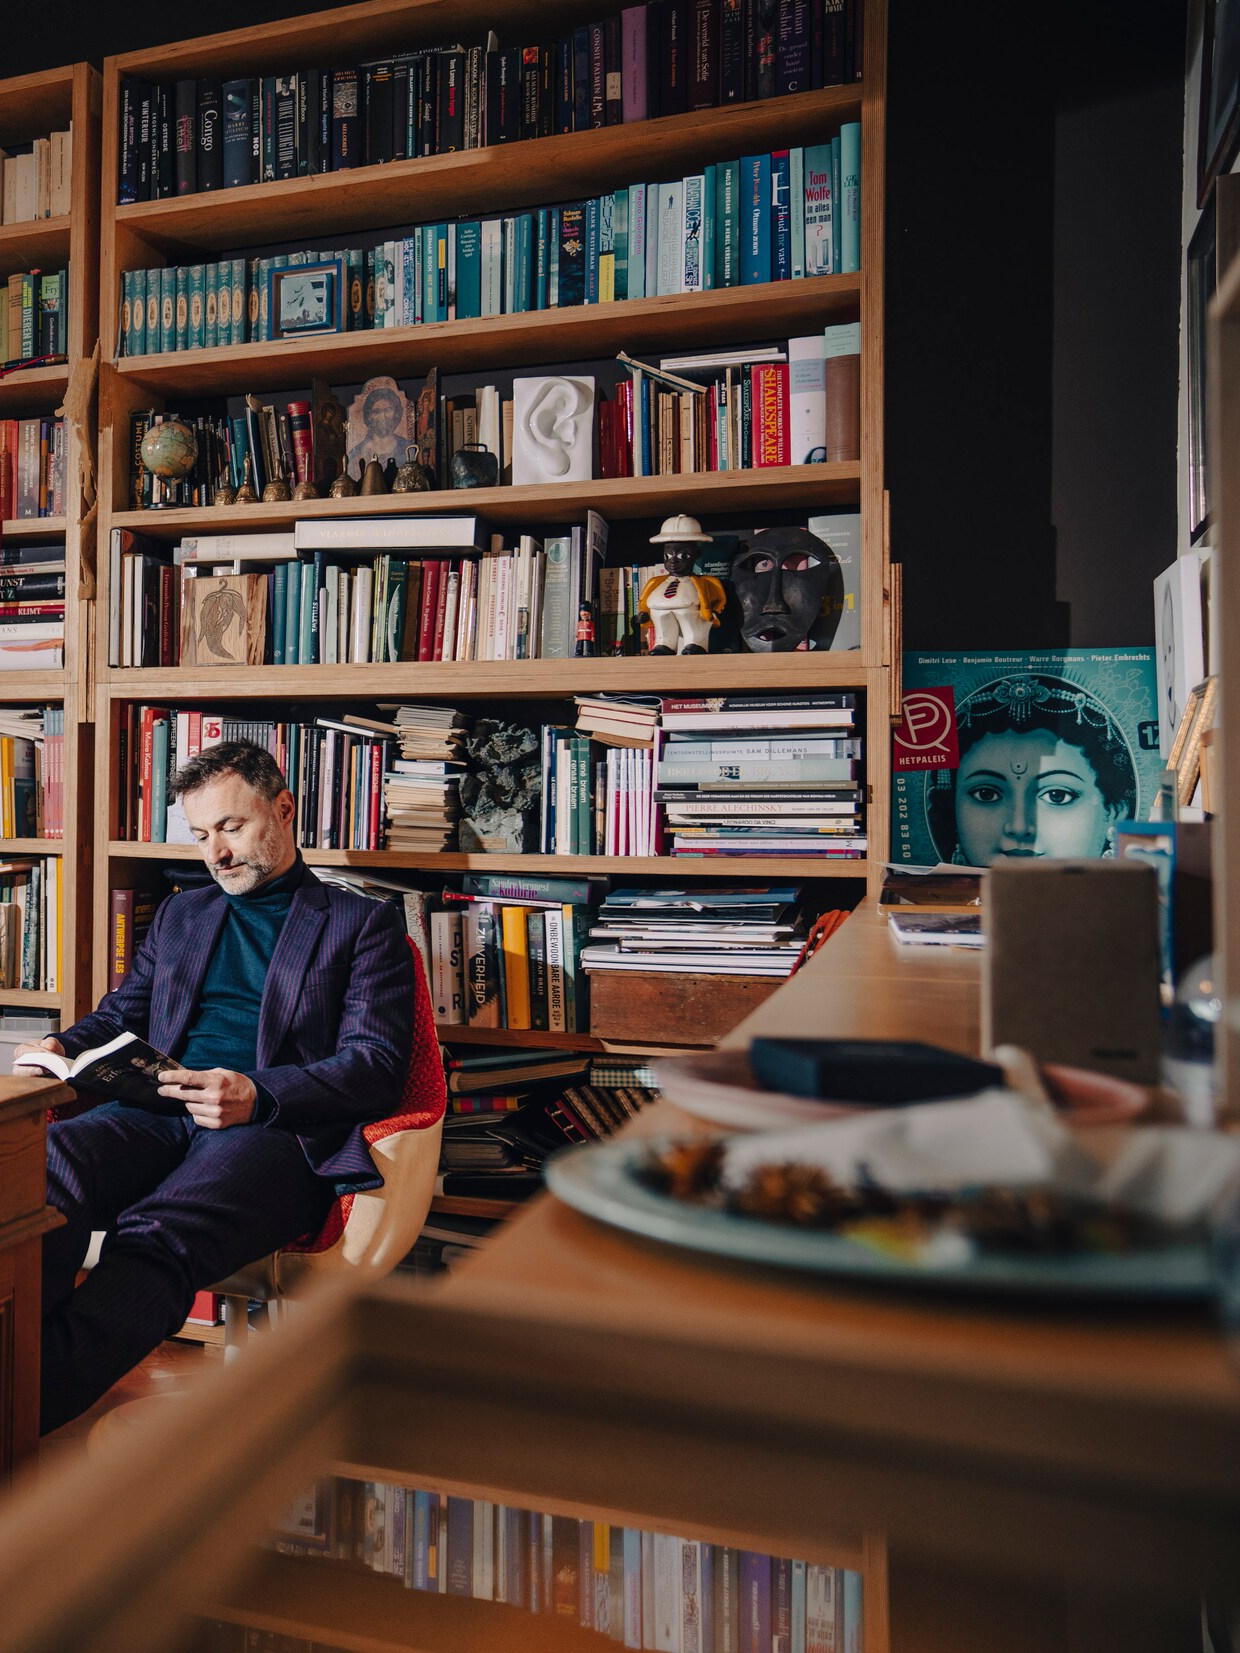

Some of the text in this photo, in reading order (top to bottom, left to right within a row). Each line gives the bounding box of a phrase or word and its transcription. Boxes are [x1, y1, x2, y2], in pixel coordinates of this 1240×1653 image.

[701, 22, 710, 48] wereld
[593, 28, 601, 94] CONNIE PALMEN
[702, 62, 710, 82] Sofie
[140, 100, 150, 142] WINTERUUR
[200, 110, 218, 151] Congo
[278, 100, 294, 162] DUKE ELLINGTON
[809, 170, 827, 186] Tom
[805, 186, 830, 202] Wolfe
[778, 206, 788, 232] Houd
[806, 204, 814, 214] in
[778, 248, 786, 265] vast
[22, 308, 32, 340] DIEREN
[764, 369, 777, 464] SHAKESPEARE
[18, 607, 42, 616] KLIMT
[962, 656, 992, 665] Benjamin
[1030, 656, 1050, 664] Warre
[1051, 655, 1085, 664] Borgmans
[1090, 654, 1113, 662] Pieter
[1114, 653, 1151, 662] Embrechts
[580, 760, 588, 777] rené
[898, 754, 947, 766] HETPALEIS
[720, 804, 784, 812] ALECHINSKY
[896, 778, 912, 859] 03 202 83 60
[115, 913, 126, 958] ANTWERPSE
[474, 927, 486, 1004] ZUIVERHEID
[549, 922, 562, 1008] ONBEWOONBARE AARDE
